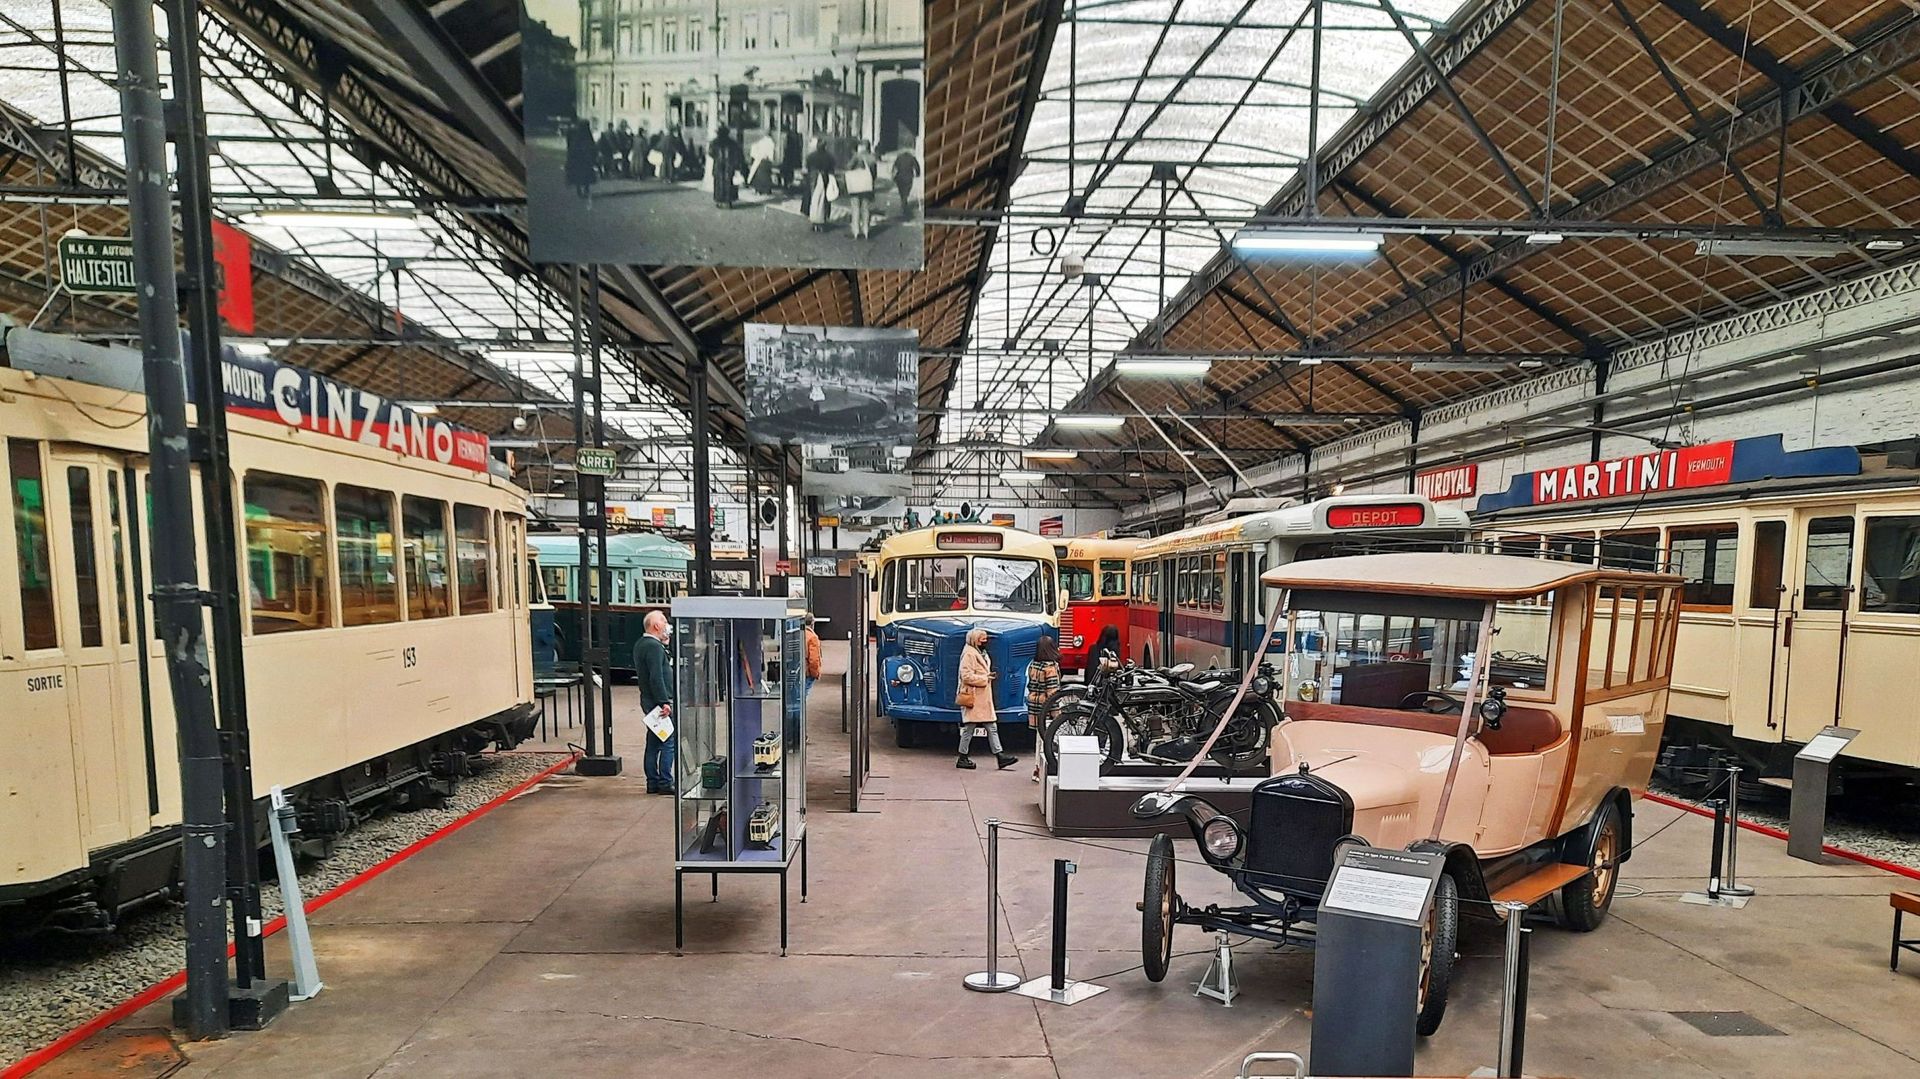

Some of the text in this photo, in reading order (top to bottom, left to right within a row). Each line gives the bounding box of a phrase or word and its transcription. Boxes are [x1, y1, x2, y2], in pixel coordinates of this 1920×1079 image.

[272, 368, 454, 464] CINZANO
[1540, 452, 1725, 502] MARTINI VERMOUTH
[1352, 511, 1398, 523] DEPOT
[1069, 549, 1084, 558] 766
[403, 647, 416, 668] 193
[27, 674, 63, 691] SORTIE
